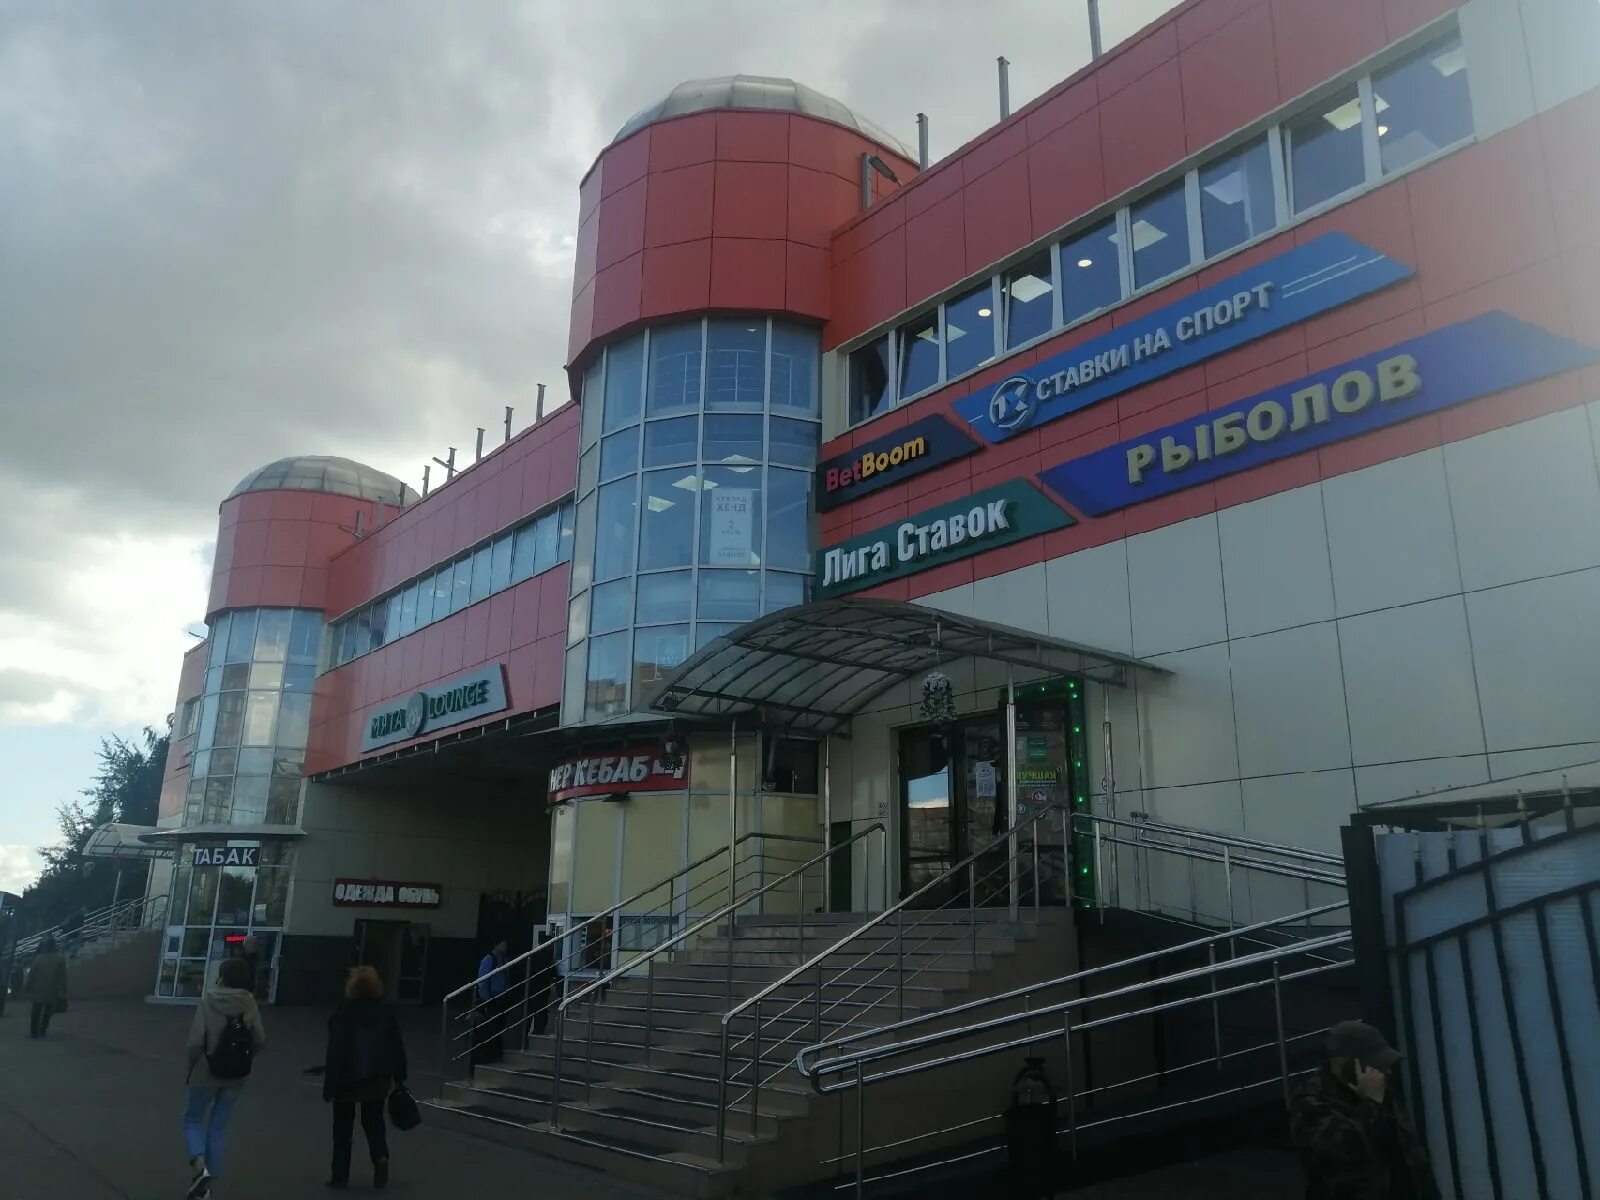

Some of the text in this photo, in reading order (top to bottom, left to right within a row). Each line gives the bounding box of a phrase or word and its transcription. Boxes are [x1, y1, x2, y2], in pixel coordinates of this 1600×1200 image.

[1036, 343, 1131, 401] СТАВКИ
[1134, 327, 1173, 361] НА
[1176, 281, 1275, 341] СПОРТ
[1126, 354, 1423, 485] РЫБОЛОВ
[825, 436, 925, 492] BetBoom
[822, 498, 1011, 587] Лига Ставок
[371, 680, 490, 739] МЯТА LOUNGE
[574, 755, 651, 786] КЕБАБ
[194, 848, 256, 865] ТАБАК
[335, 883, 439, 904] ОДЕЖДА ОБУВЬ
